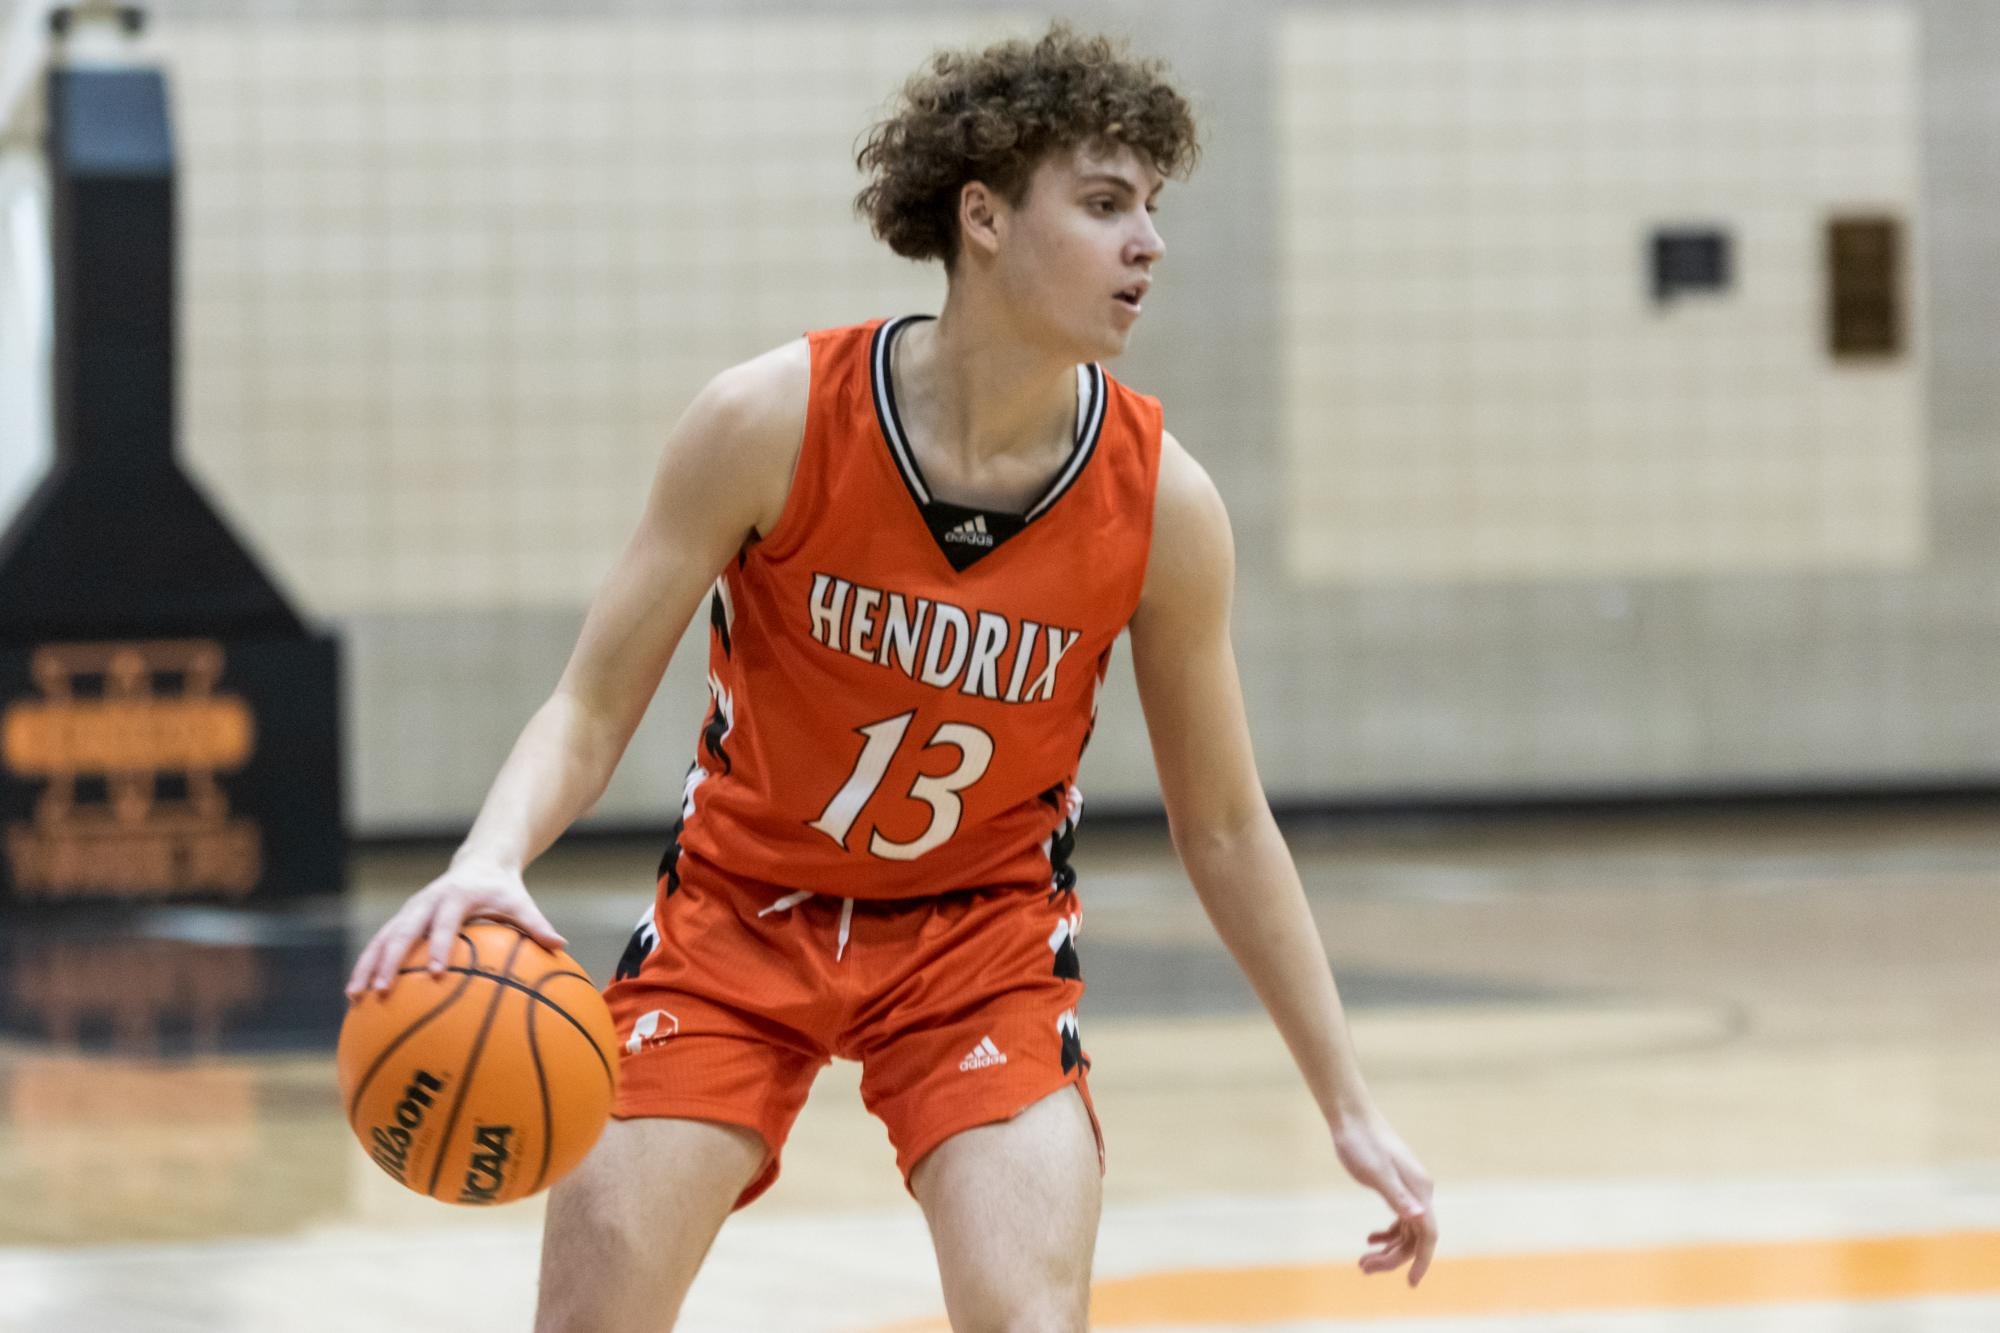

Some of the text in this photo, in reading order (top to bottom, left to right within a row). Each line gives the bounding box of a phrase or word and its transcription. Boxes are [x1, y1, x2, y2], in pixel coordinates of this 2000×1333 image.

[944, 530, 994, 547] adidas
[809, 572, 1082, 704] HENDRIX
[804, 708, 996, 861] 13
[959, 1052, 1008, 1072] adidas
